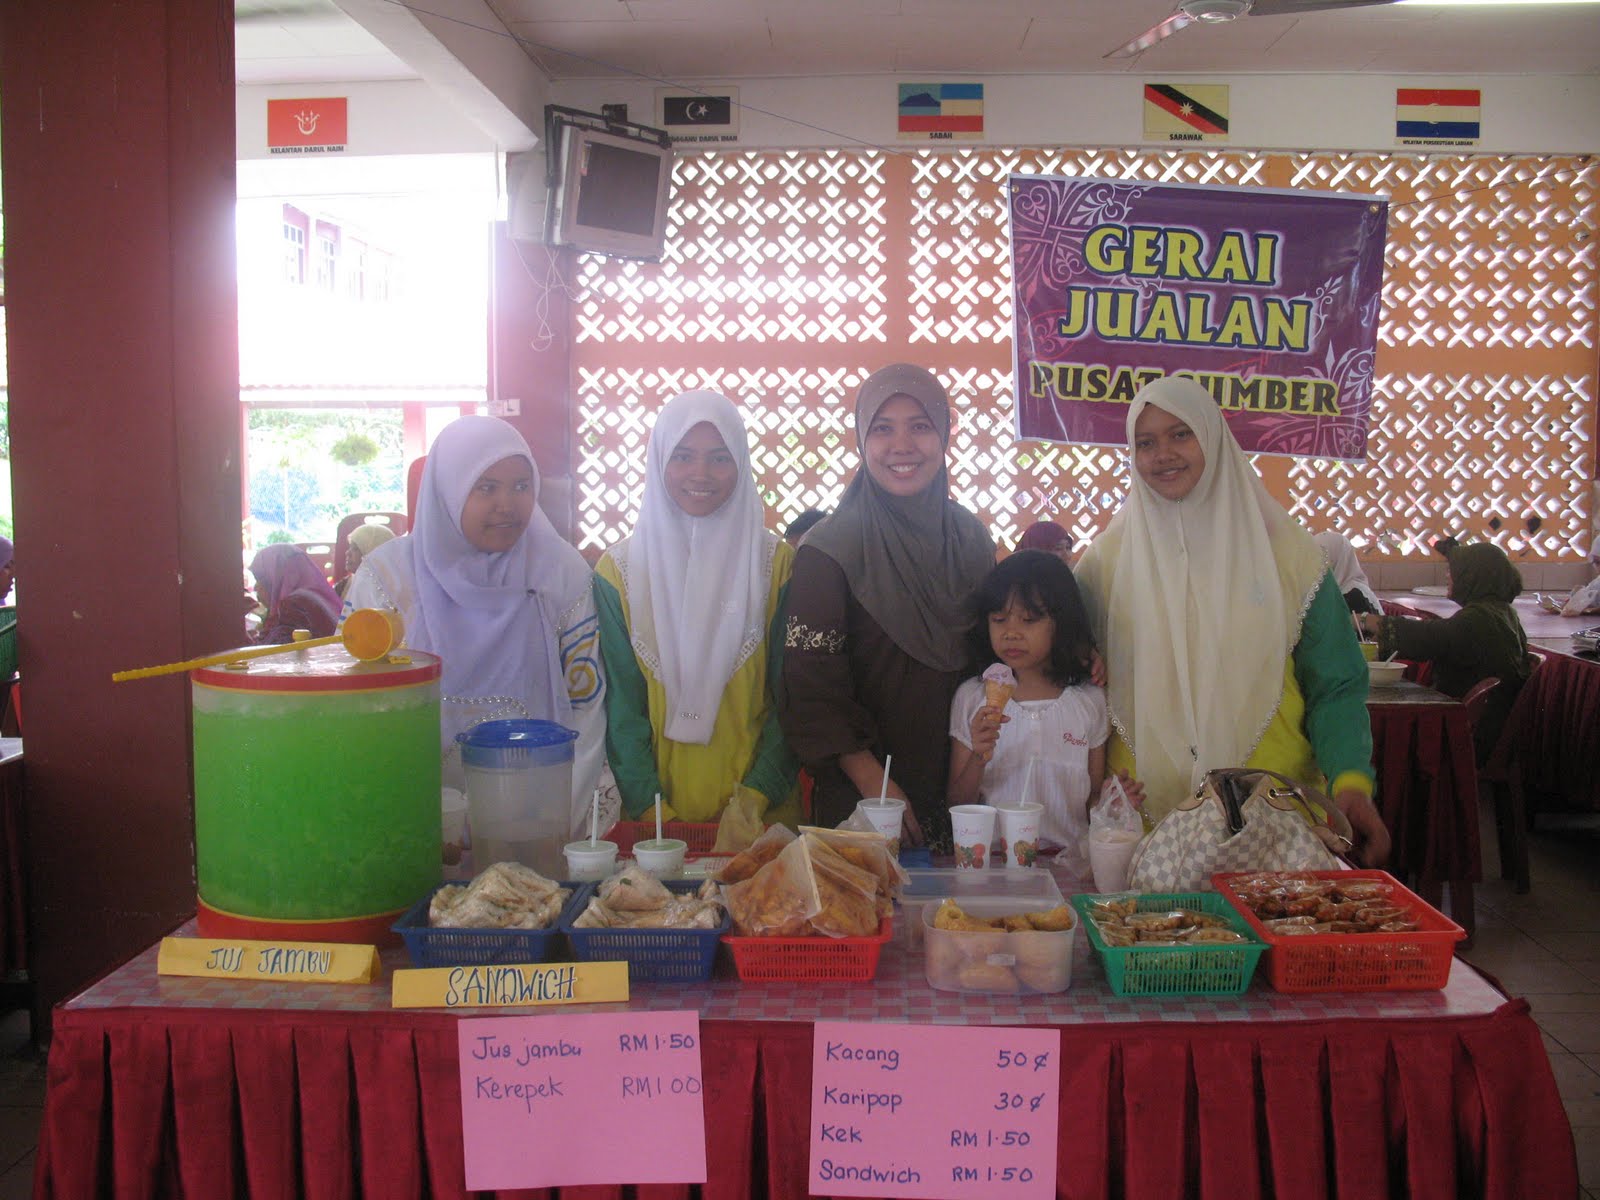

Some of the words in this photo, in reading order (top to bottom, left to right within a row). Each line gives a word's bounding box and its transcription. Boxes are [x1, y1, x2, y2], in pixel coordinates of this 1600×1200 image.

[1169, 133, 1203, 141] SARAWAK
[1082, 223, 1279, 287] GERAI
[1059, 286, 1313, 352] JUALAN
[1171, 368, 1341, 416] UMBER
[206, 947, 243, 972] JUS
[257, 947, 330, 975] JAMBU
[472, 1036, 511, 1060] Jus
[517, 1037, 582, 1066] jambu
[826, 1041, 900, 1070] Kacang
[476, 1075, 564, 1113] Kerepek
[823, 1085, 903, 1114] Karipop
[821, 1123, 863, 1143] Kek
[819, 1159, 921, 1184] Sandwich
